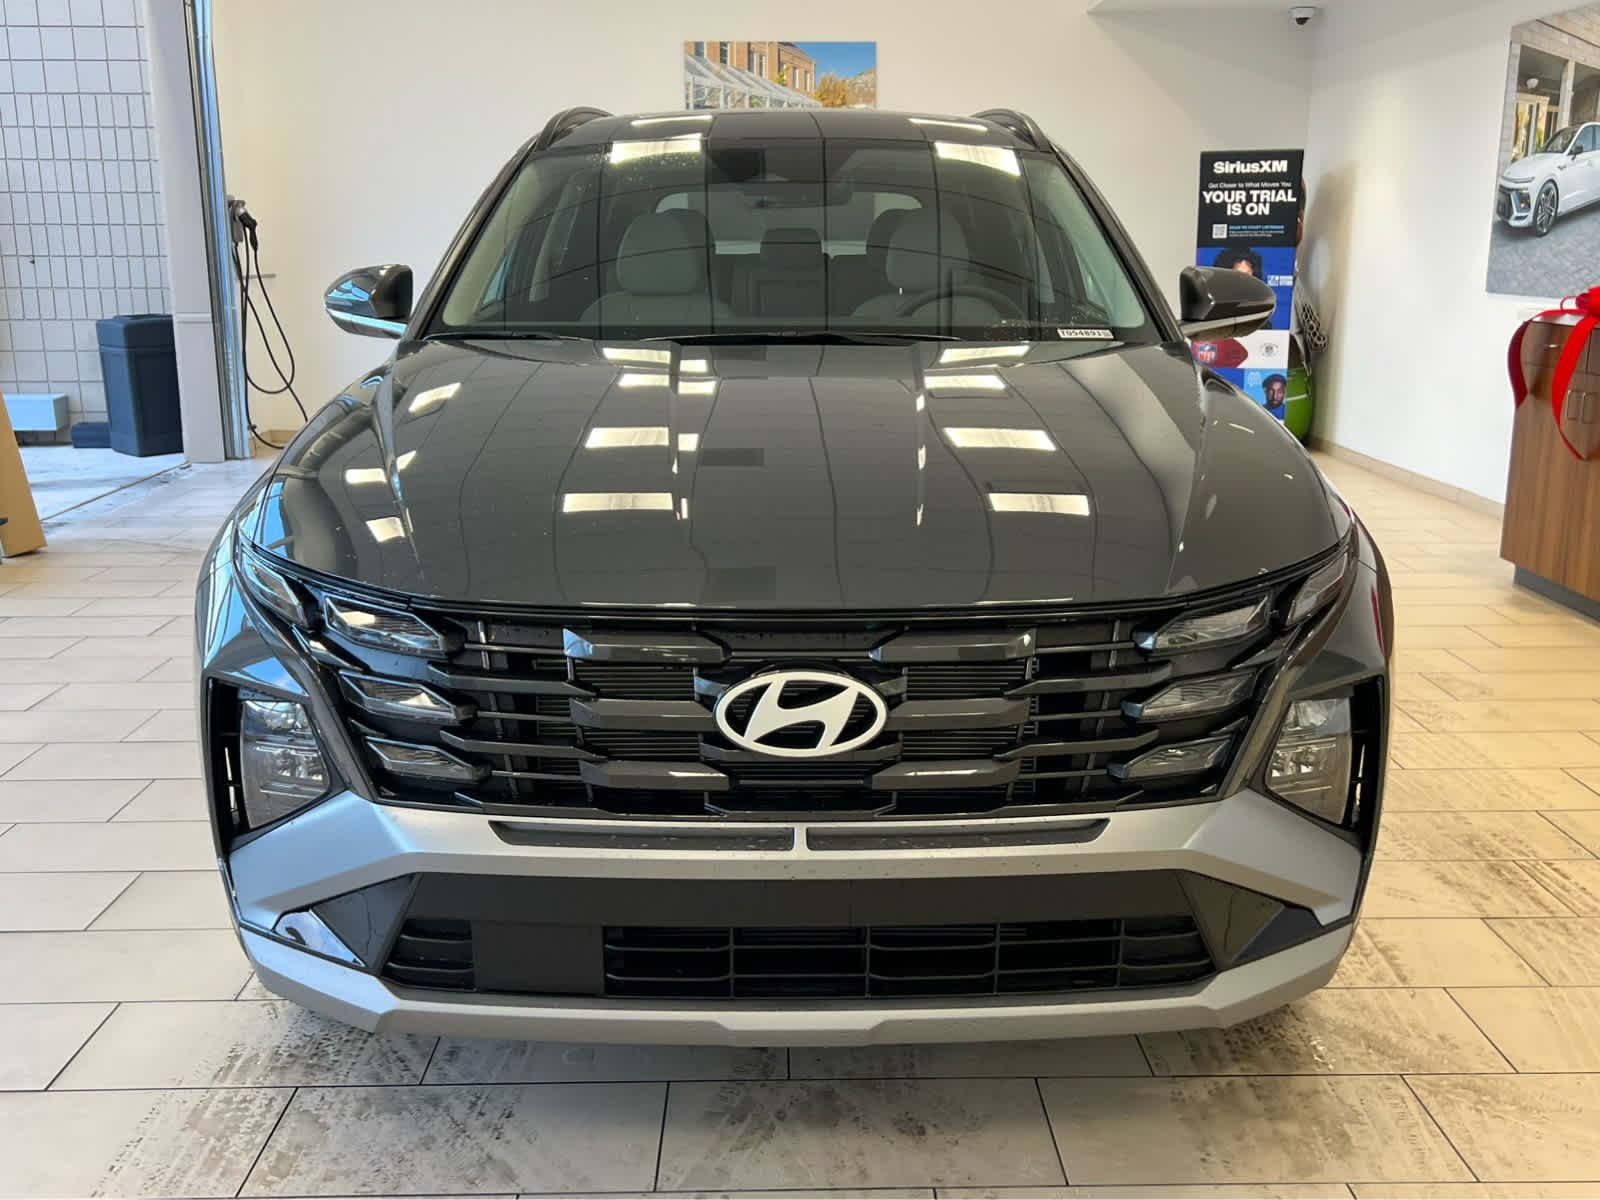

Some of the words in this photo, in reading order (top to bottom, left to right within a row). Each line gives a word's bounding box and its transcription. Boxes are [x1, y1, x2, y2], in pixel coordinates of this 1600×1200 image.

[1213, 160, 1288, 174] SiriusXM
[1202, 190, 1246, 204] YOUR
[1249, 189, 1297, 203] TRIAL
[1226, 203, 1243, 216] IS
[1245, 203, 1270, 216] ON
